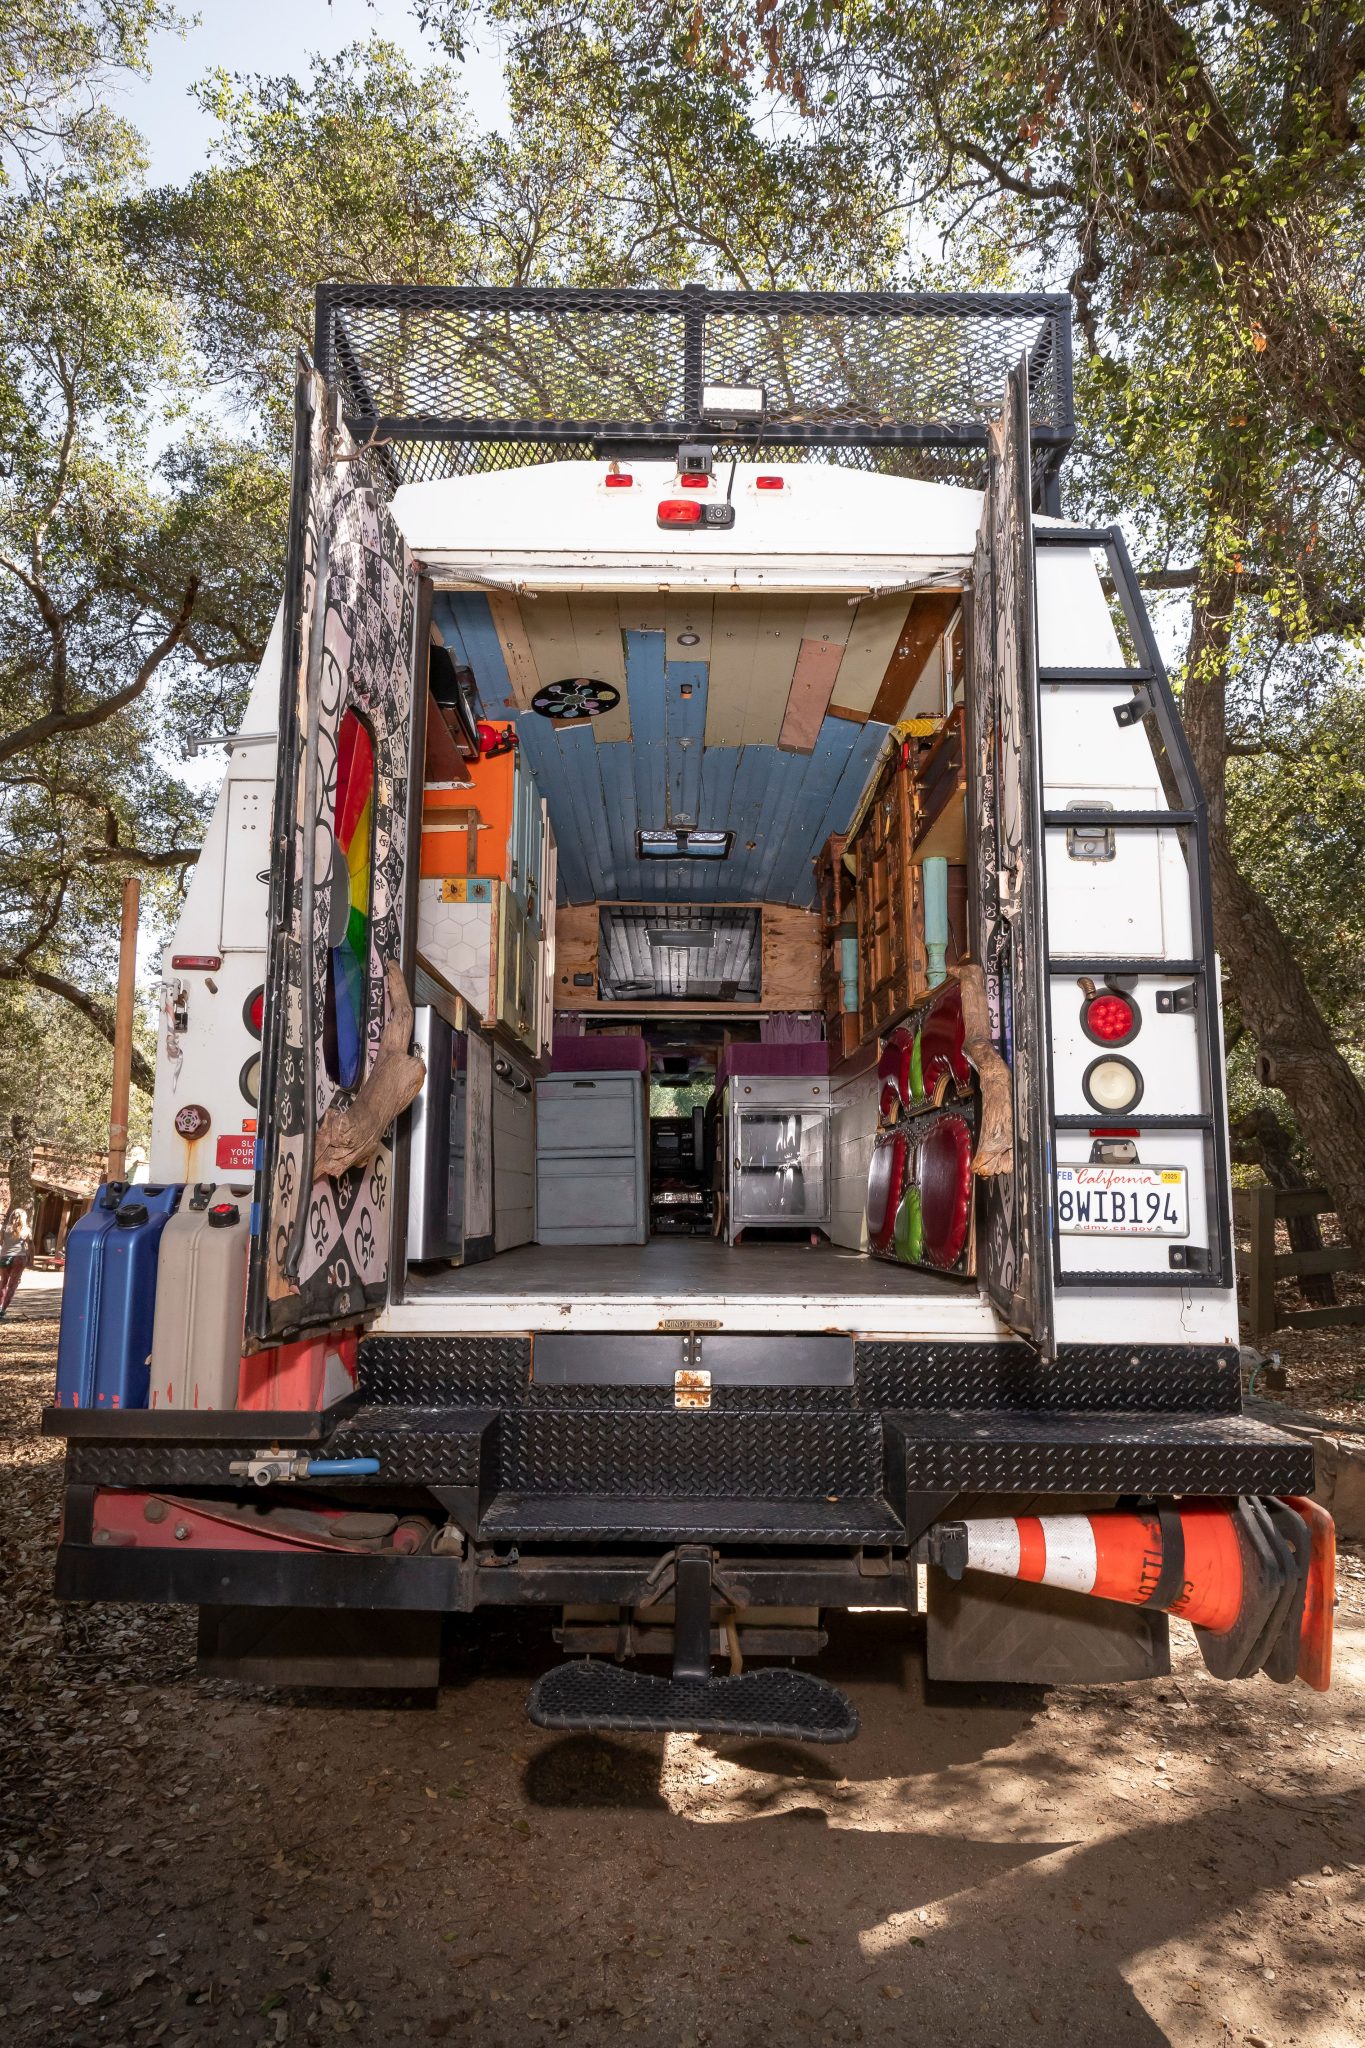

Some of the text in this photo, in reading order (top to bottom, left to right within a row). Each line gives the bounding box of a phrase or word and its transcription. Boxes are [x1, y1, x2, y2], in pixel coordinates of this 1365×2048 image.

[229, 1157, 238, 1165] IS
[1057, 1171, 1073, 1181] FEB
[1077, 1168, 1161, 1189] California
[1059, 1190, 1178, 1224] 8WIB194
[665, 1320, 716, 1328] MIND THE STEP
